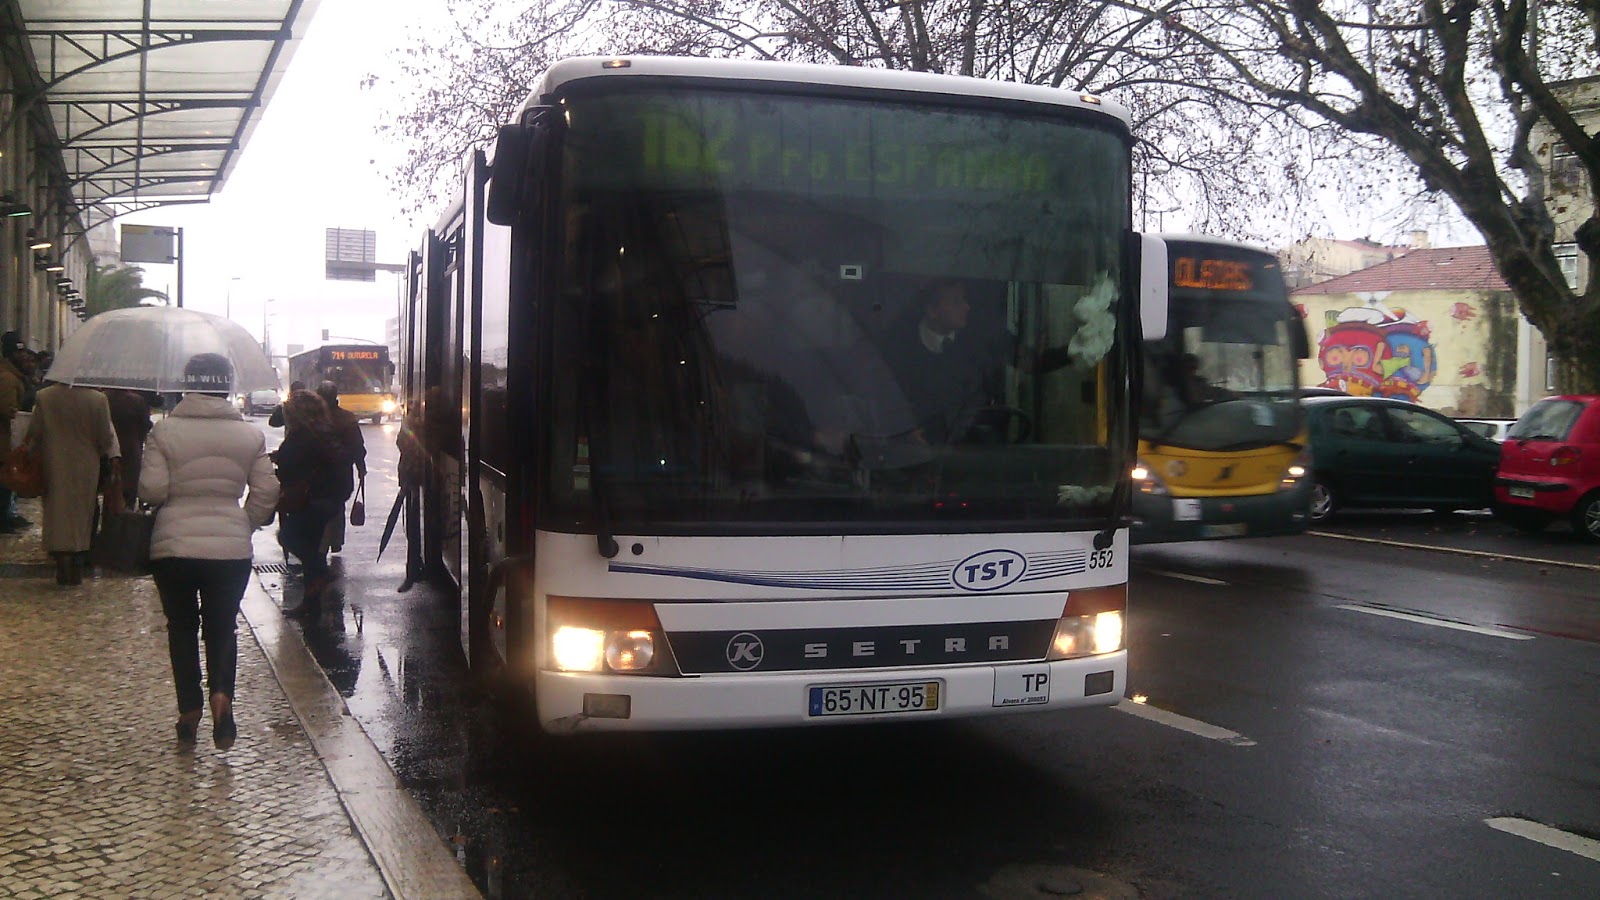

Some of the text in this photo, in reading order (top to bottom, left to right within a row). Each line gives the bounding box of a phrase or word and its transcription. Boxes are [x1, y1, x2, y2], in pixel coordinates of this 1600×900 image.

[332, 351, 345, 360] 714
[1089, 550, 1114, 570] 552
[964, 559, 1014, 583] TST
[804, 635, 1009, 658] SETRA
[1021, 673, 1048, 692] TP
